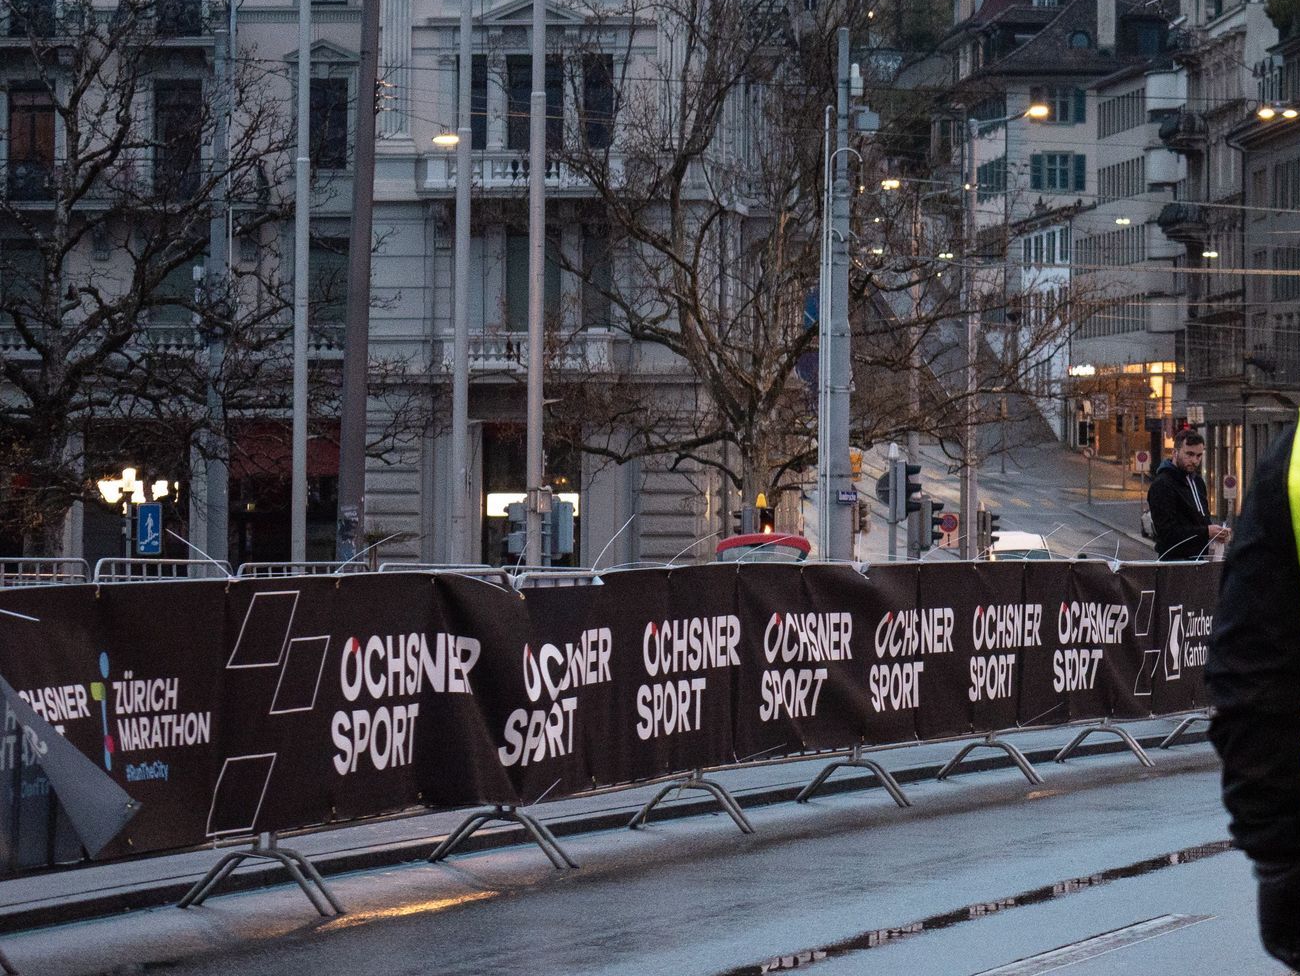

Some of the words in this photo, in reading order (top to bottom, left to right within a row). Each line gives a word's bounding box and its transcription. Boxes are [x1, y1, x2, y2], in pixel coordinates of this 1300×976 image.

[643, 614, 741, 677] OCHSNER
[764, 611, 852, 665] OCHSNER
[874, 607, 955, 659] OCHSNER
[973, 603, 1041, 651] OCHSNER
[1058, 600, 1129, 645] OCHSNER
[1185, 608, 1214, 638] Zürcher
[112, 671, 179, 715] ZÜRICH
[341, 632, 482, 702] OCHSNER
[869, 661, 924, 713] SPORT
[968, 653, 1016, 702] SPORT
[1053, 648, 1103, 693] SPORT
[636, 677, 706, 741] SPORT
[759, 667, 827, 722] SPORT
[117, 711, 211, 752] MARATHON
[331, 702, 420, 776] SPORT
